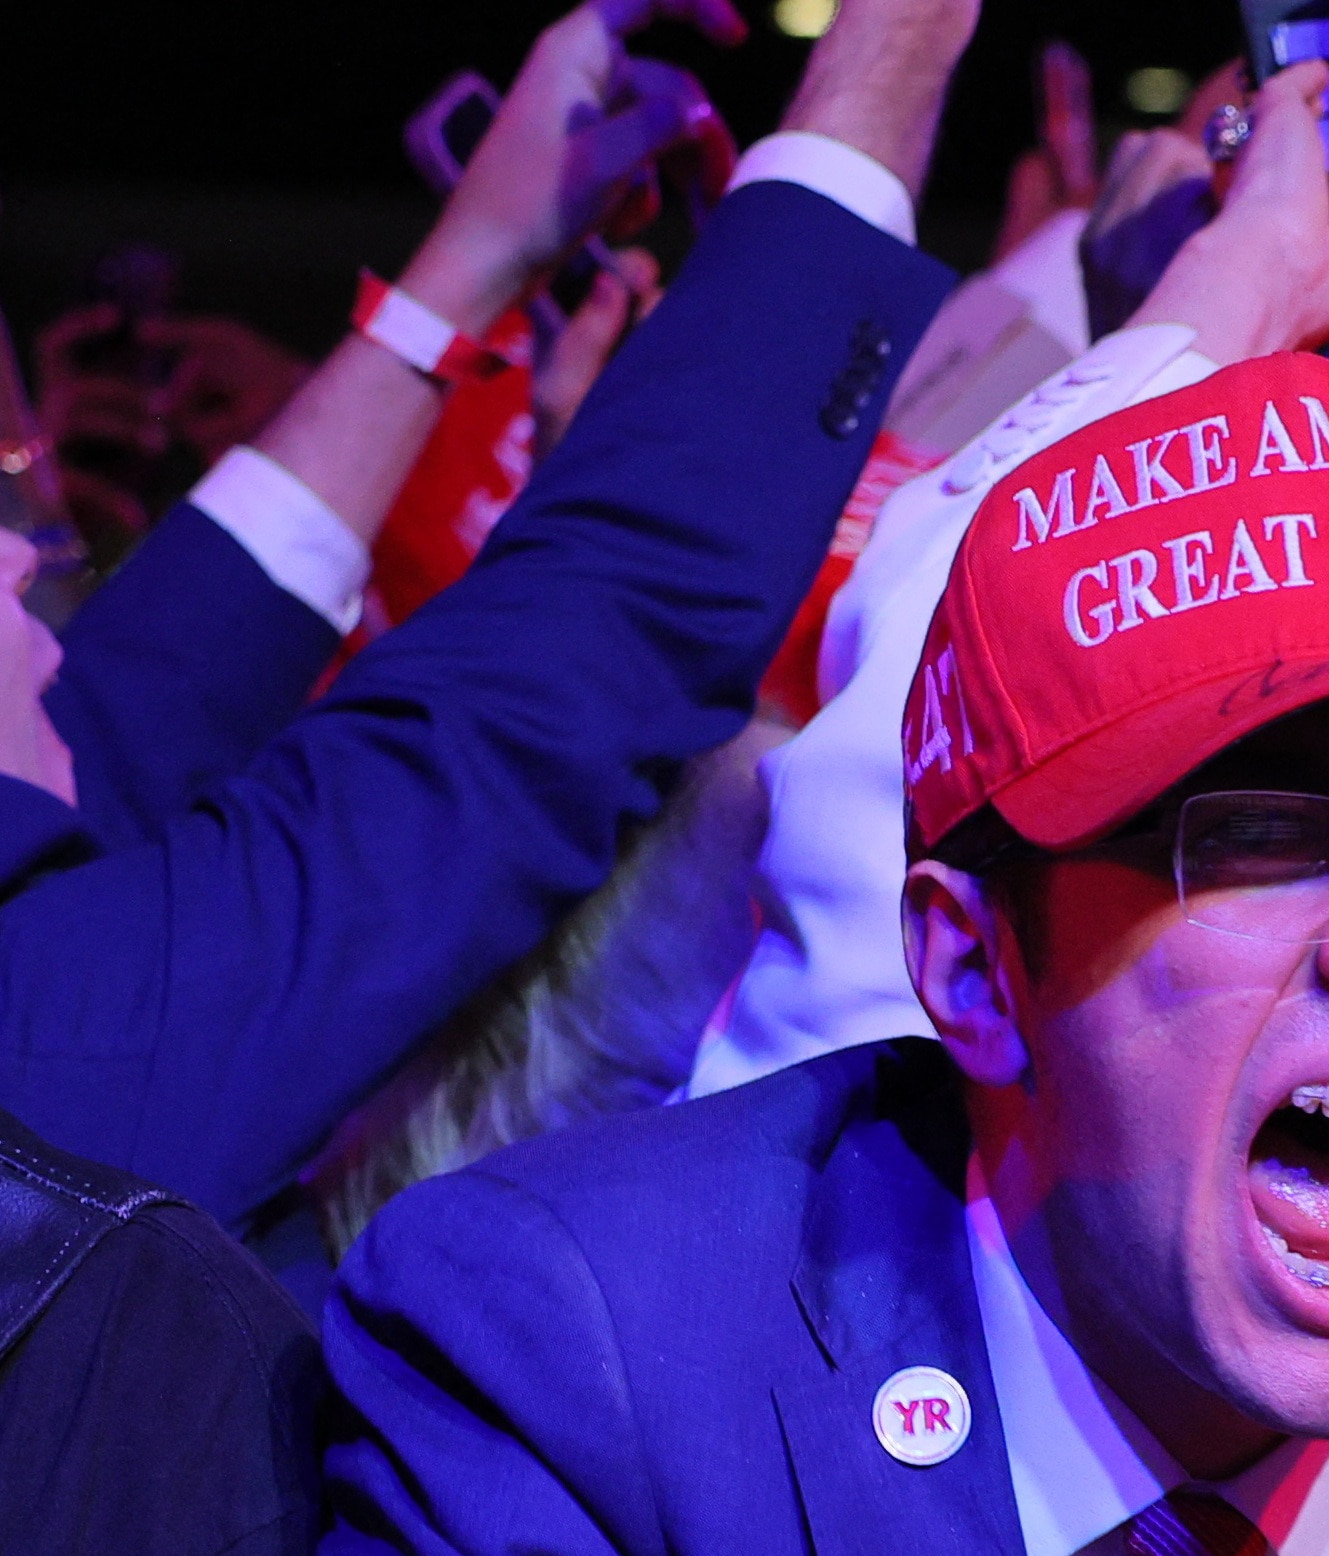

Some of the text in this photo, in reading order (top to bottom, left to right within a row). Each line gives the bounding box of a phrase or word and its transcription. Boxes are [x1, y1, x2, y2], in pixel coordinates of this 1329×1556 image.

[1011, 415, 1237, 552] MAKE
[1062, 513, 1318, 648] GREAT
[891, 1397, 953, 1436] YR
